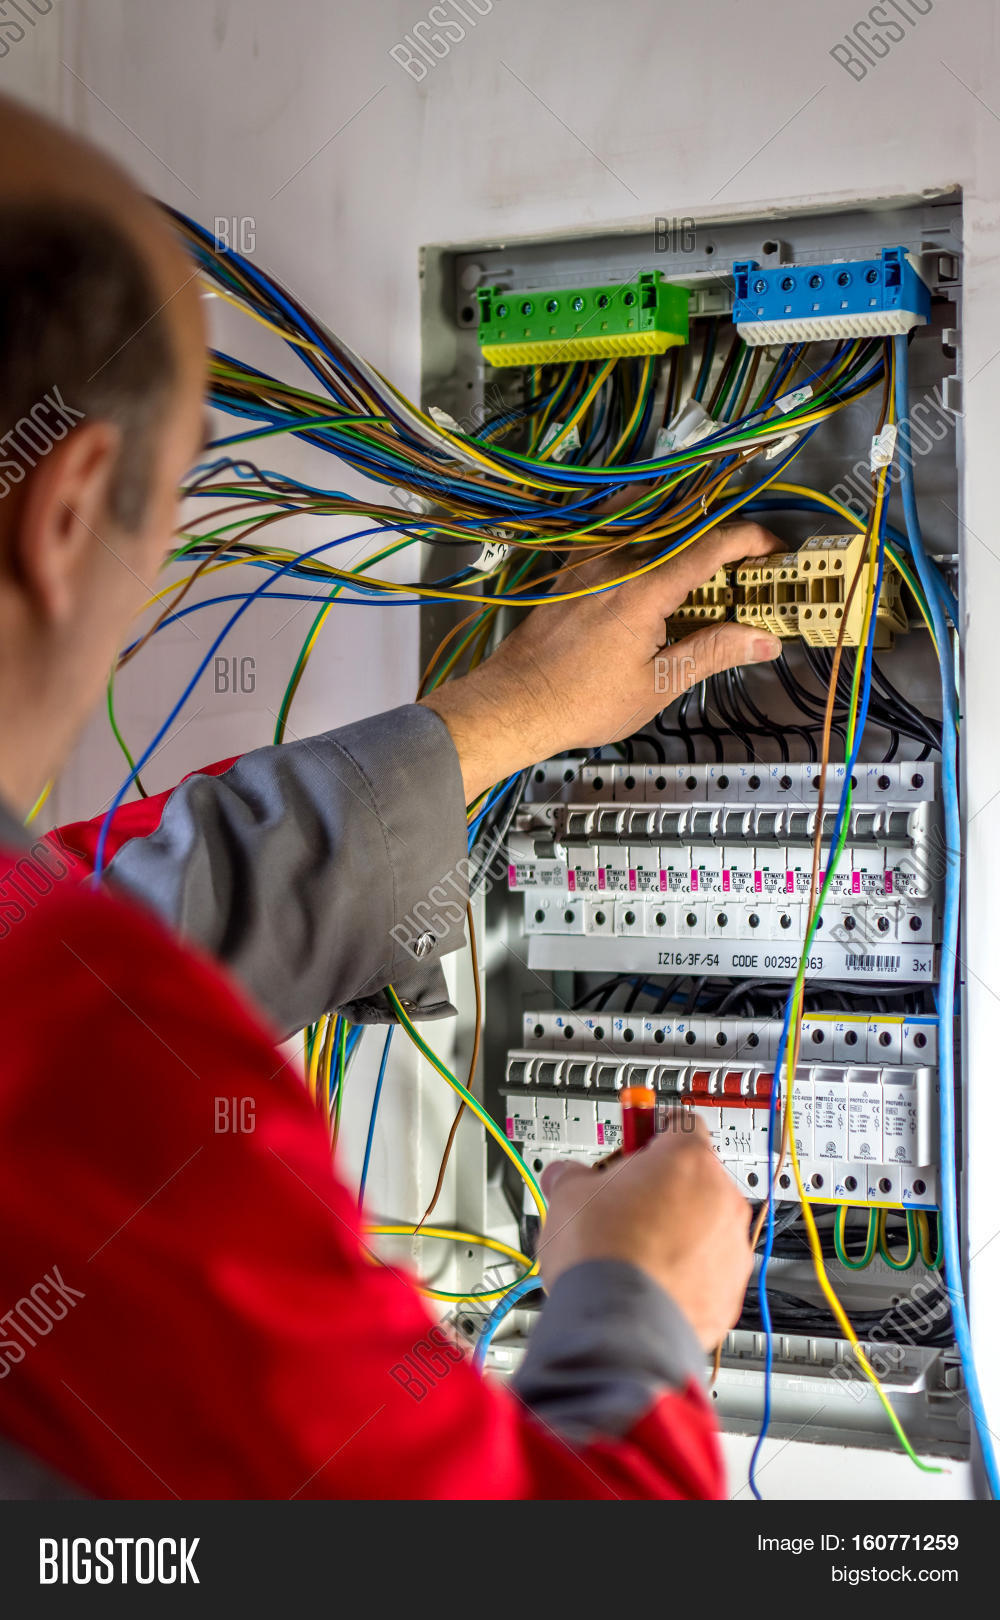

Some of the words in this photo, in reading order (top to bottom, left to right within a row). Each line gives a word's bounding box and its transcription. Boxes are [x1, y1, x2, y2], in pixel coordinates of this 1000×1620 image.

[658, 953, 719, 966] IZ16/3F/54
[732, 955, 758, 967] CODE
[725, 1137, 730, 1146] 3
